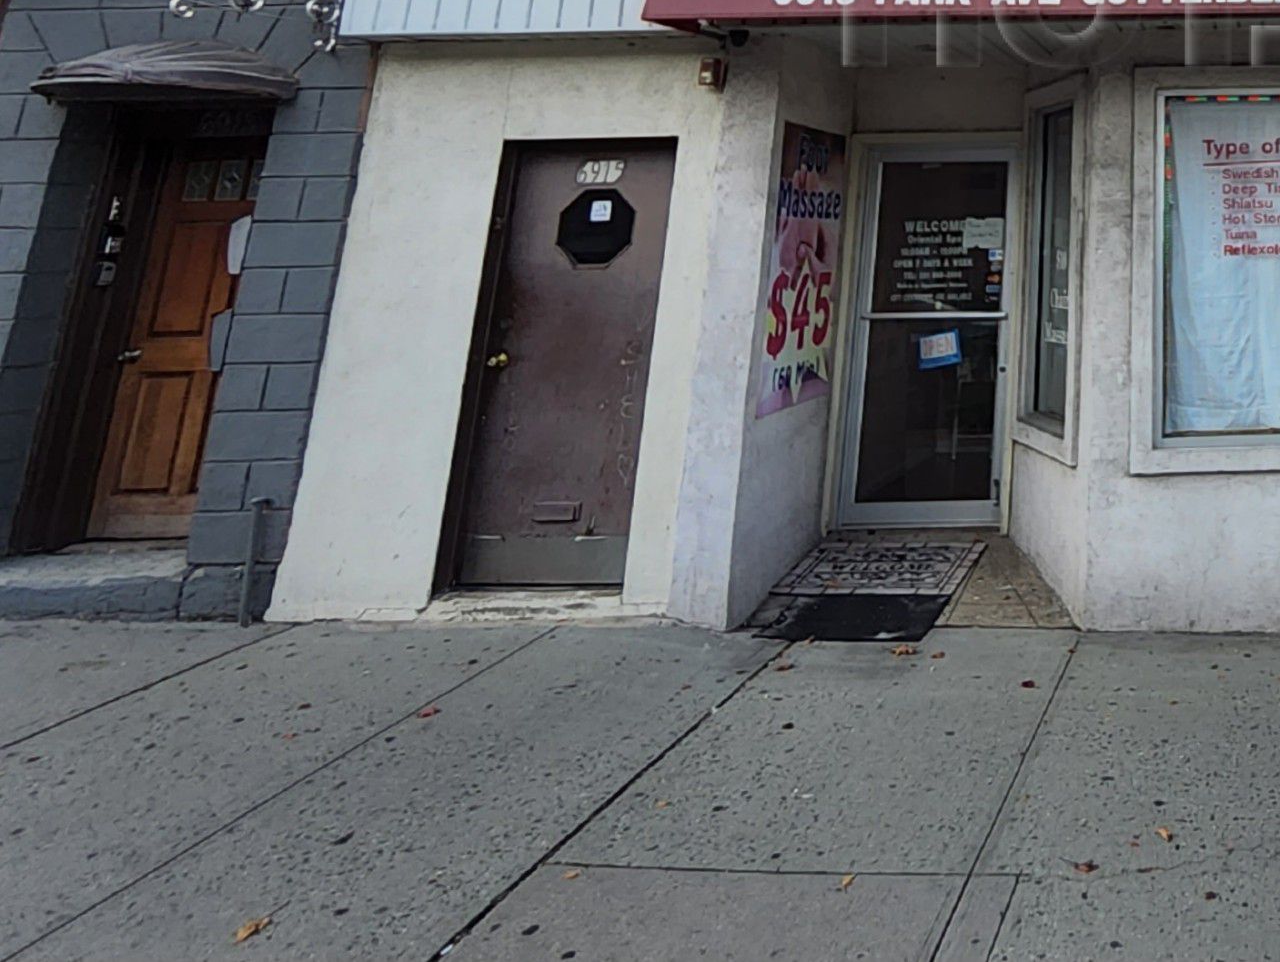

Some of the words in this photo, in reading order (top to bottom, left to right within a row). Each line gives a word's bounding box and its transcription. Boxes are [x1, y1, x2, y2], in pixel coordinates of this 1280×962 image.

[1203, 138, 1250, 159] Type
[1262, 138, 1280, 154] of
[1222, 168, 1279, 180] Swedish
[1222, 183, 1258, 196] Deep
[777, 180, 841, 220] Massage
[1222, 198, 1273, 210] Shiatsu
[1222, 213, 1246, 225] Hot
[766, 270, 832, 361] $45
